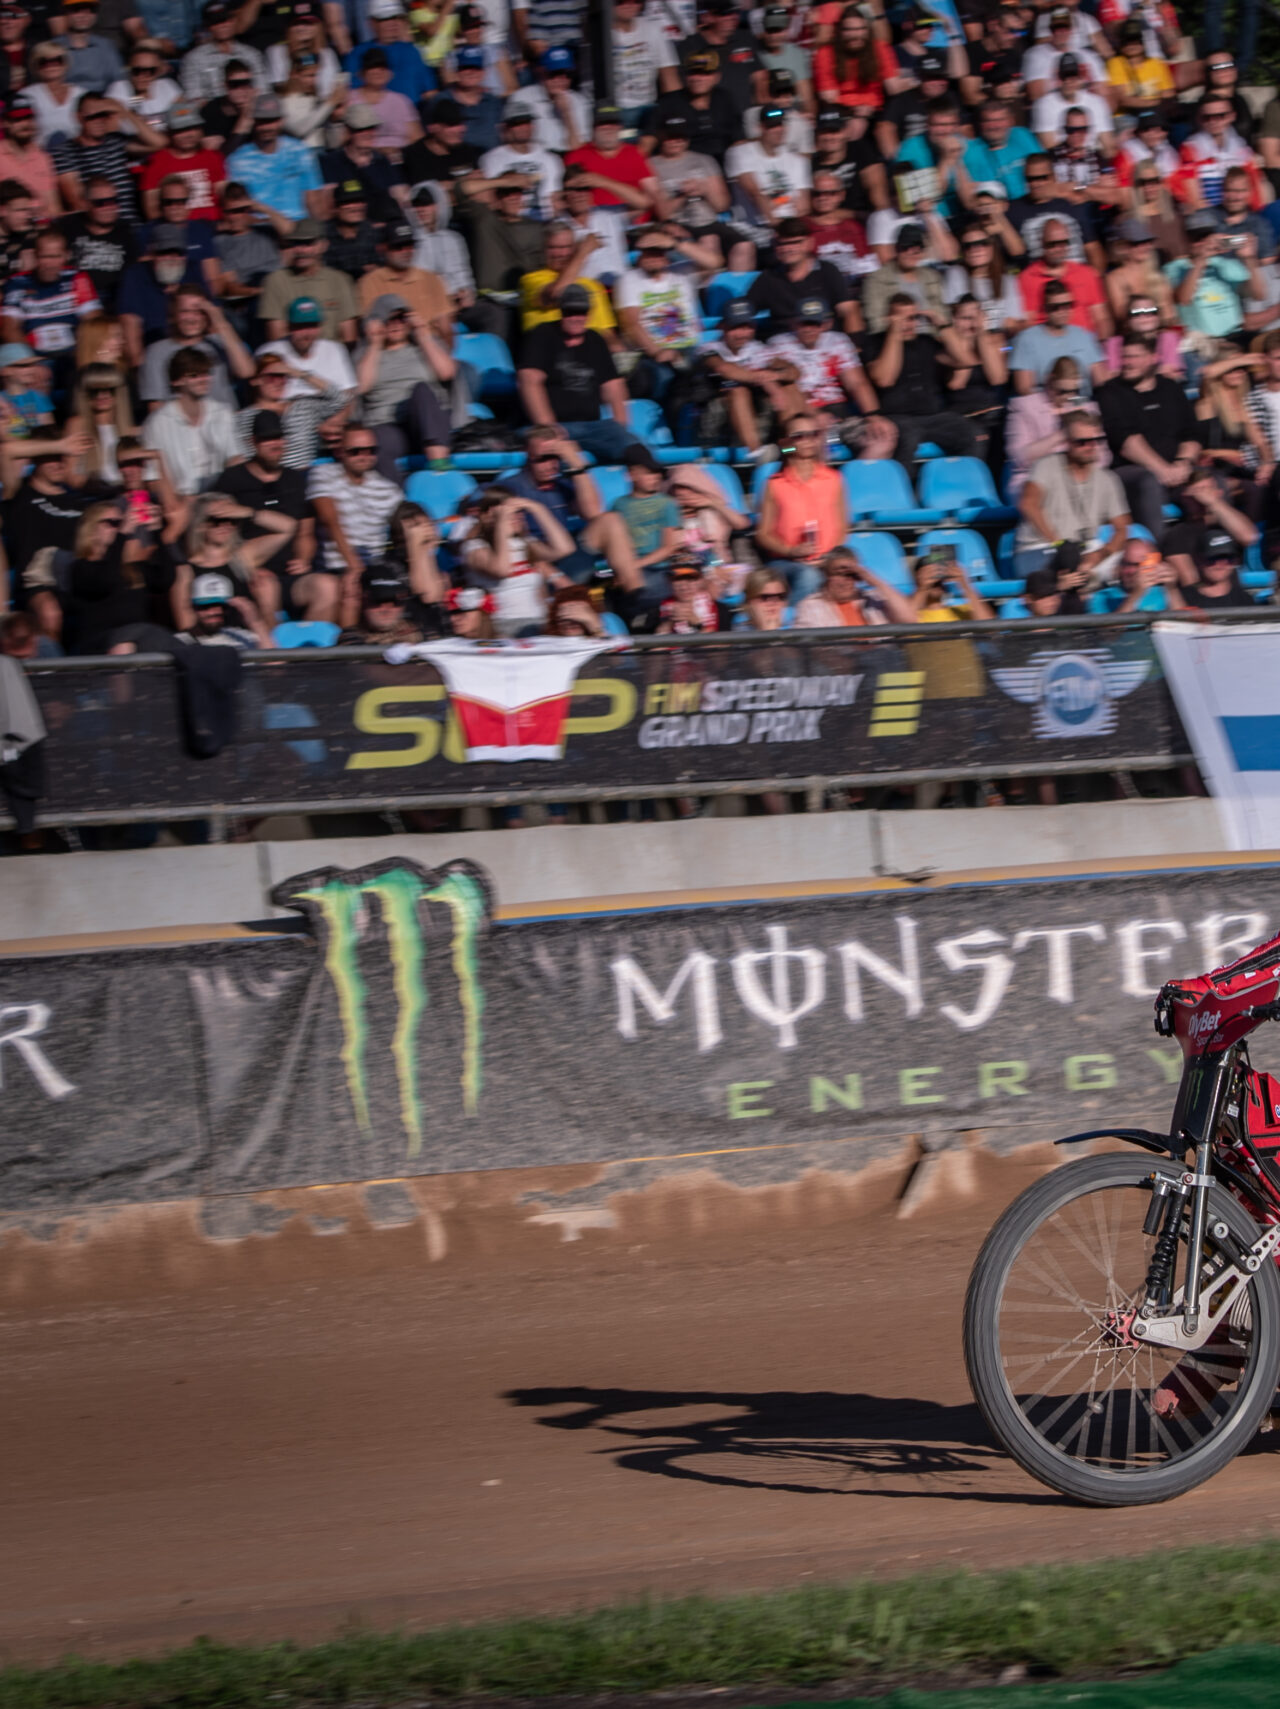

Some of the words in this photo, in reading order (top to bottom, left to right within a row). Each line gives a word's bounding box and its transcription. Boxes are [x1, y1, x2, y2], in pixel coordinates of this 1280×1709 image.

[345, 677, 638, 770] SP
[700, 674, 864, 712] SPEEDWAY
[638, 712, 749, 750] GRAND
[746, 708, 823, 744] PRIX
[611, 911, 1271, 1051] MONSTER
[730, 1051, 1184, 1120] ENERGY
